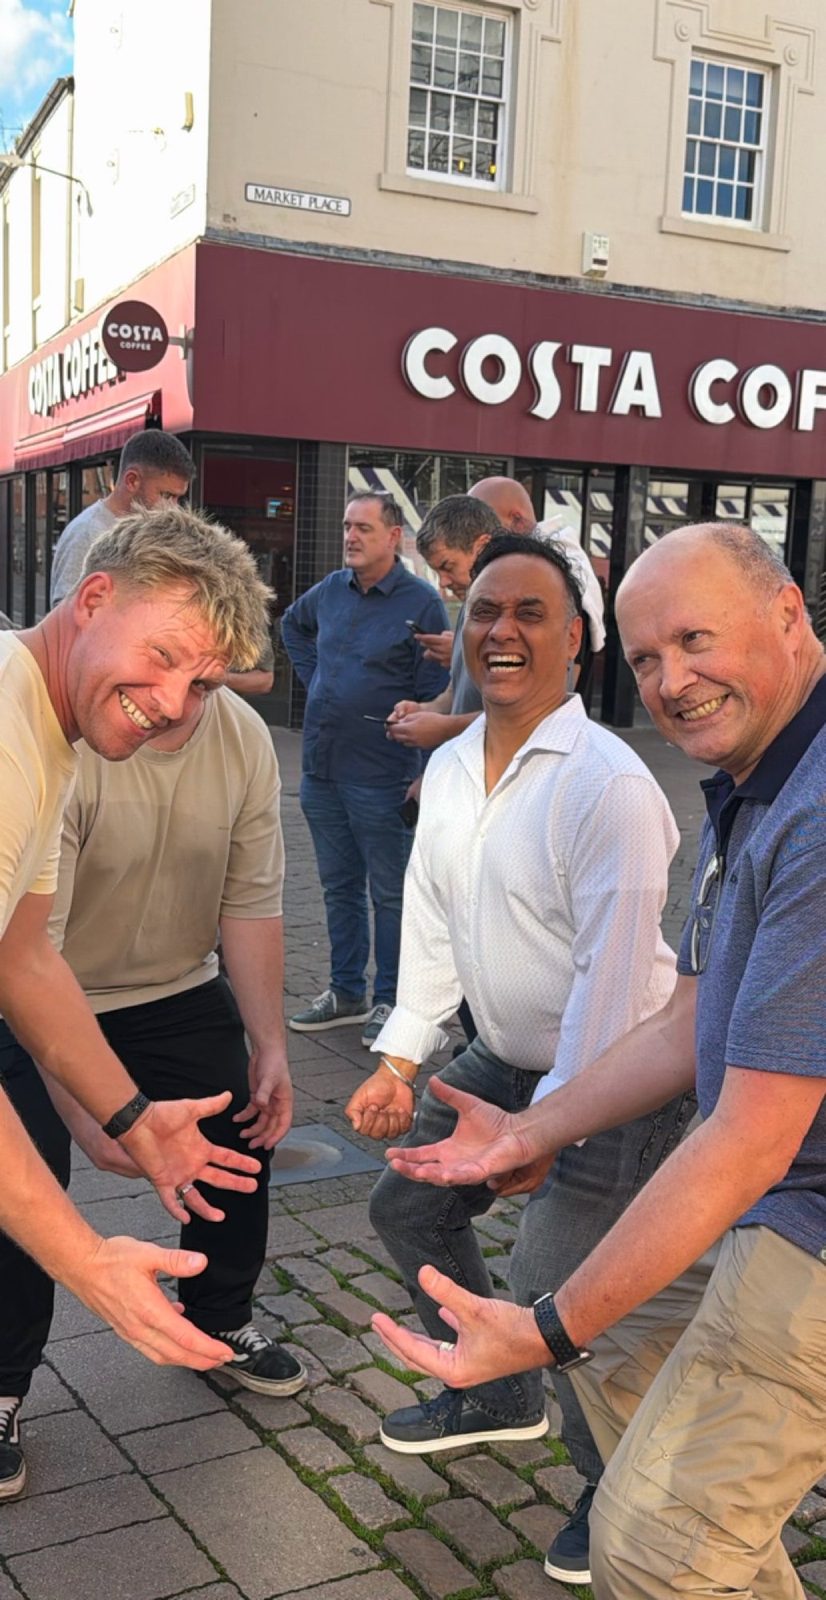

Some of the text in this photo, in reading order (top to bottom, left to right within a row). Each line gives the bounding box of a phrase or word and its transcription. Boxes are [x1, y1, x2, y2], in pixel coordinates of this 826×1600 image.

[254, 187, 342, 212] MARKET PLACE
[107, 323, 163, 342] COSTA
[120, 341, 151, 351] COFFEE
[28, 352, 63, 417] COSTA
[403, 326, 826, 432] COSTA COF
